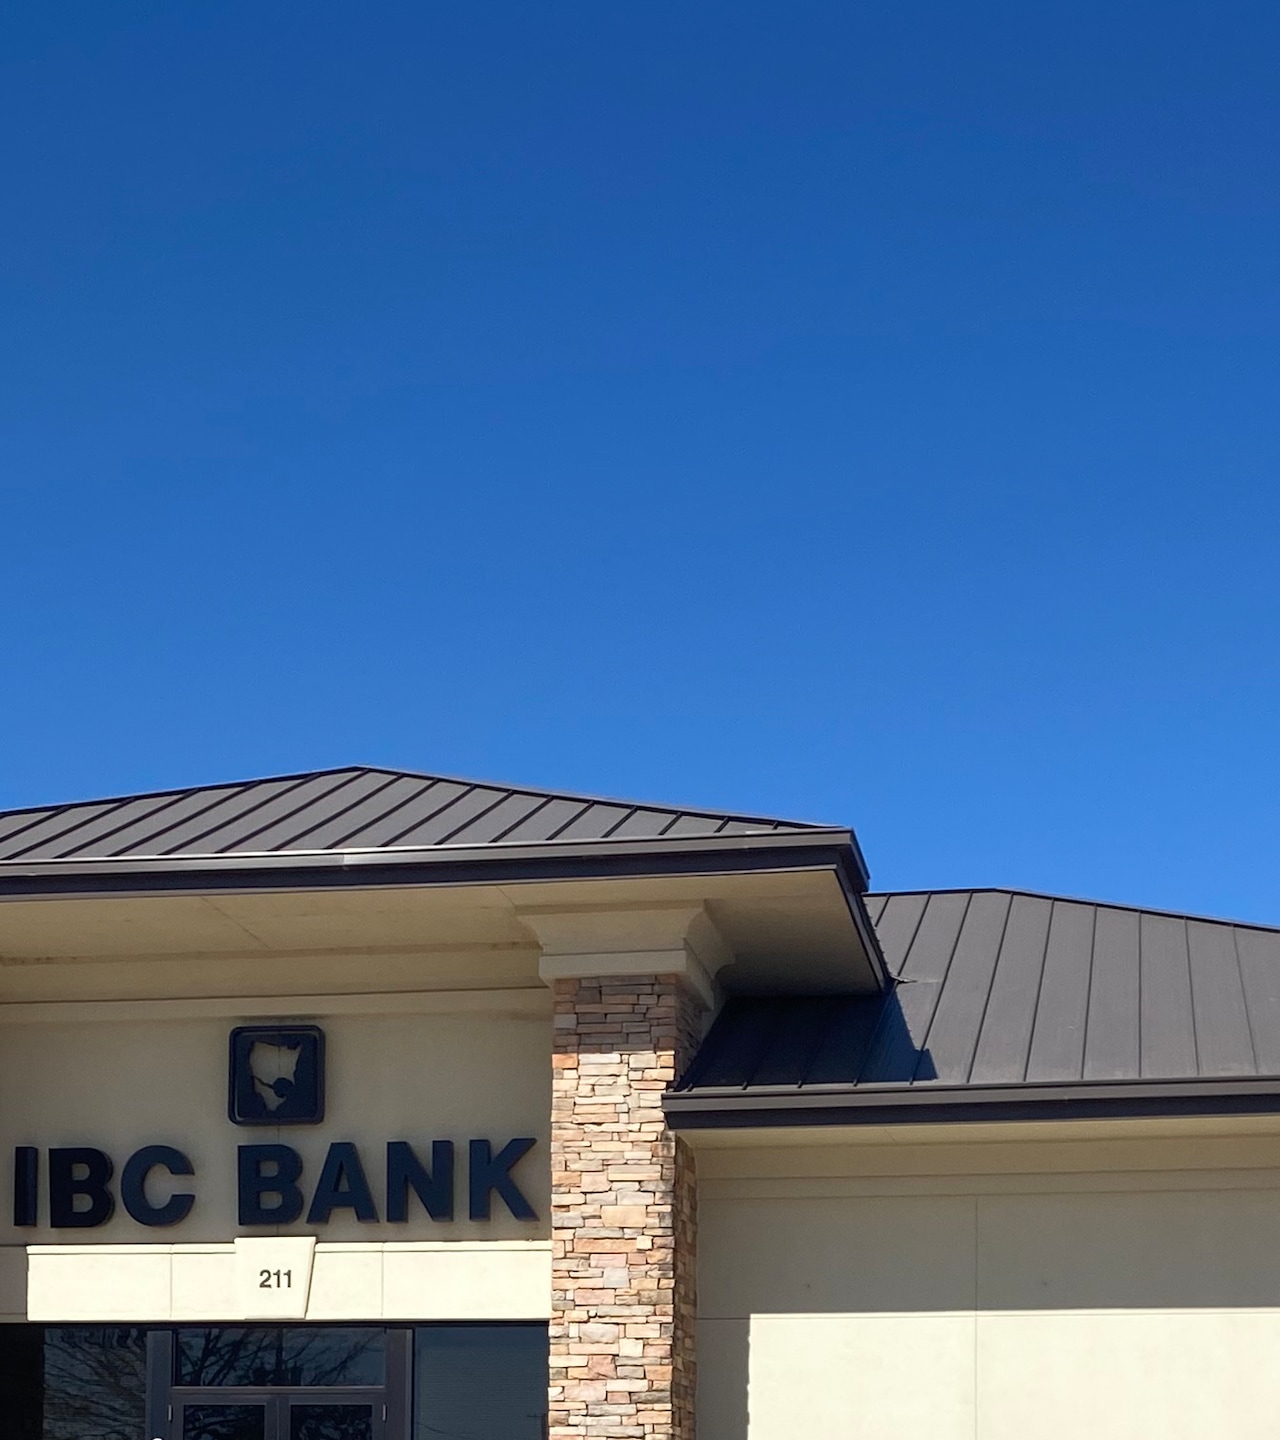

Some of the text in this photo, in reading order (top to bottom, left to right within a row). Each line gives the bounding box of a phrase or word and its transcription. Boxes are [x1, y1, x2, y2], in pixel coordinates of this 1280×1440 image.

[13, 1137, 540, 1228] IBC BANK
[259, 1269, 291, 1288] 211
